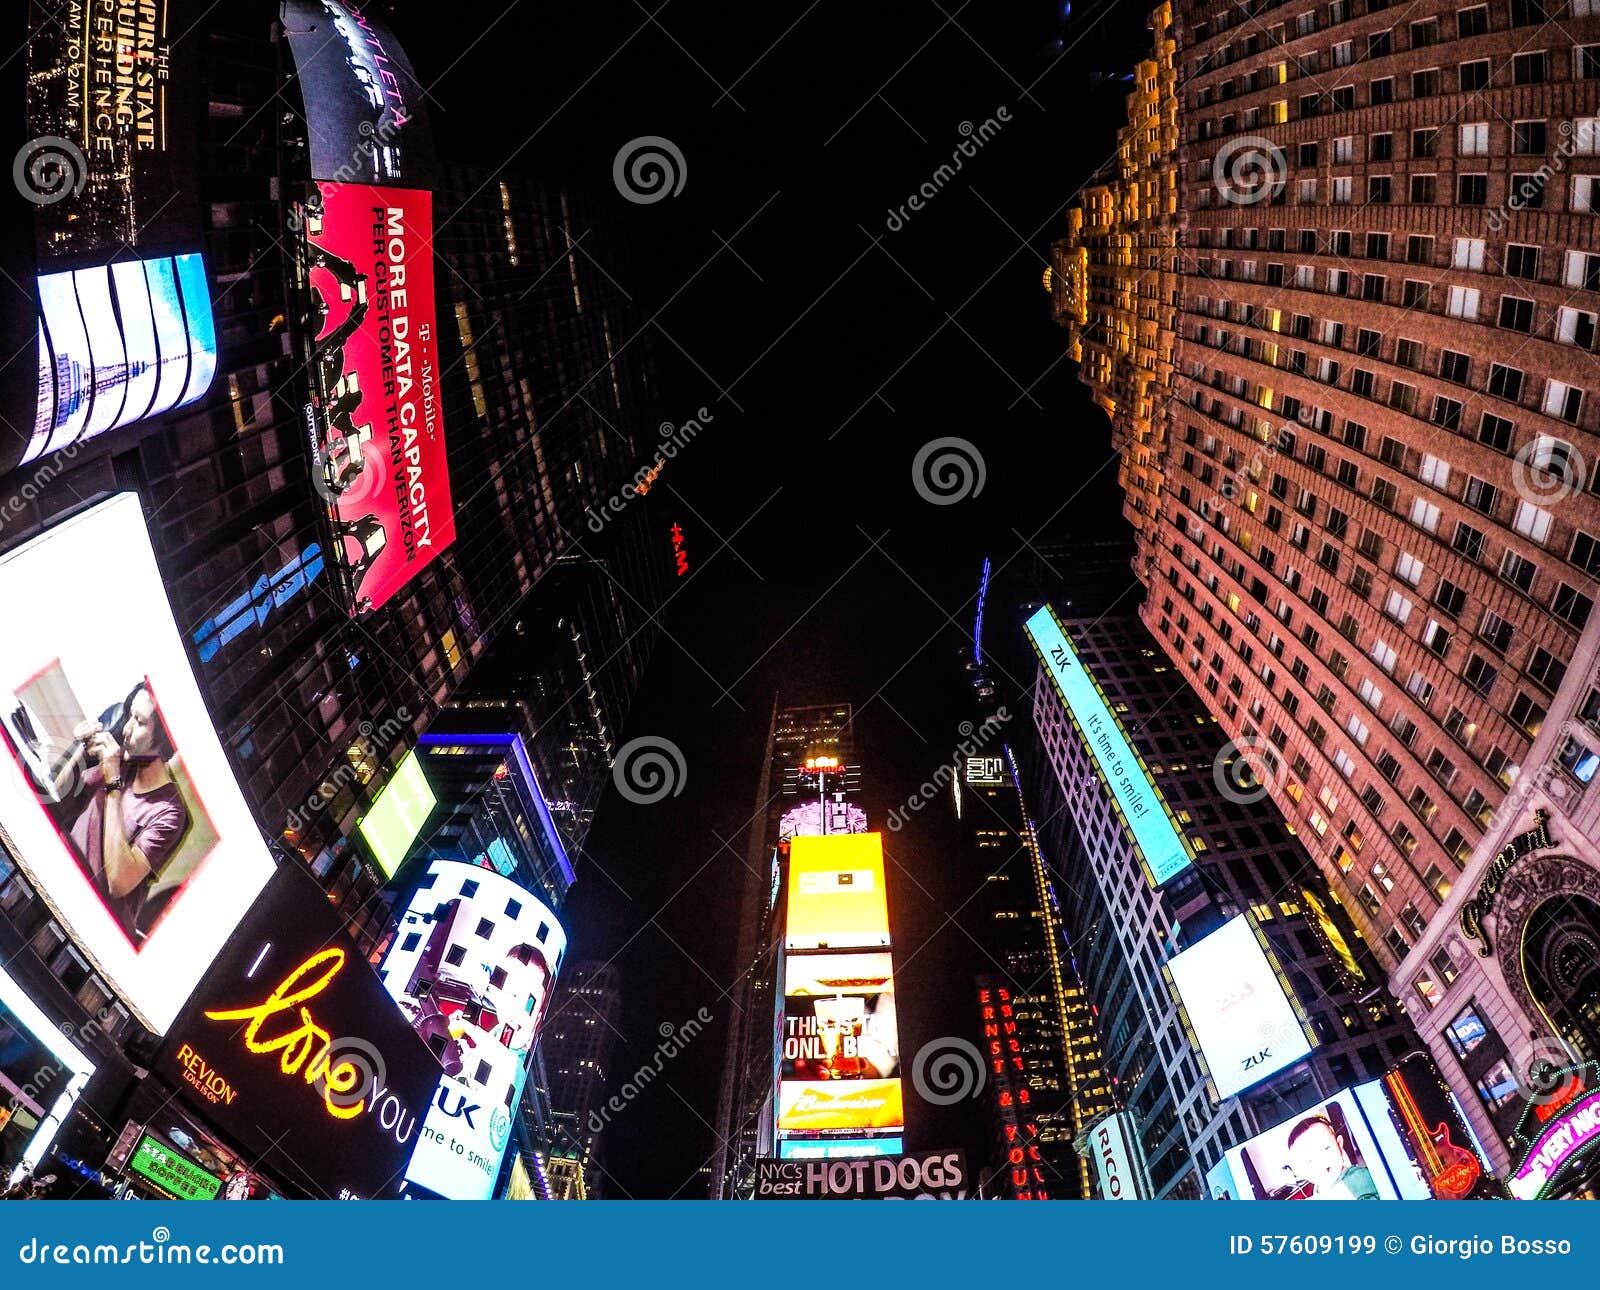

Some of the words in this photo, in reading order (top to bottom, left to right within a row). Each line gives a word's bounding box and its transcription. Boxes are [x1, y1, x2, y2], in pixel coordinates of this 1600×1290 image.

[67, 37, 81, 59] TO
[158, 45, 170, 80] THE
[66, 67, 81, 107] 2AM
[373, 54, 403, 105] LET
[390, 106, 409, 127] A
[136, 72, 155, 150] STATE
[371, 207, 386, 256] PER
[387, 207, 408, 310] MORE
[374, 261, 395, 397] CUSTOMER
[392, 316, 413, 398] DATA
[305, 404, 321, 465] OUTFRONT
[385, 401, 405, 466] THAN
[400, 401, 432, 548] CAPACITY
[394, 467, 417, 563] VERIZON
[1050, 643, 1072, 673] ZUK
[1087, 712, 1105, 738] It's
[1094, 736, 1116, 762] time
[1111, 760, 1125, 777] to
[1119, 775, 1150, 819] smile!
[247, 942, 271, 978] I
[204, 947, 365, 1120] love
[979, 988, 1005, 1074] ERNST
[999, 1091, 1013, 1107] &
[177, 1044, 237, 1105] REVLON
[1240, 1047, 1272, 1071] ZUK
[367, 1075, 416, 1144] YOU
[431, 1085, 481, 1130] UK
[142, 1143, 217, 1194] STARBUCKS
[450, 1136, 464, 1155] to
[1098, 1127, 1123, 1200] RICO
[148, 1161, 197, 1196] COFFEE
[759, 1162, 803, 1179] NYC's
[759, 1179, 803, 1195] best
[806, 1160, 870, 1195] HOT
[874, 1153, 963, 1193] DOGS
